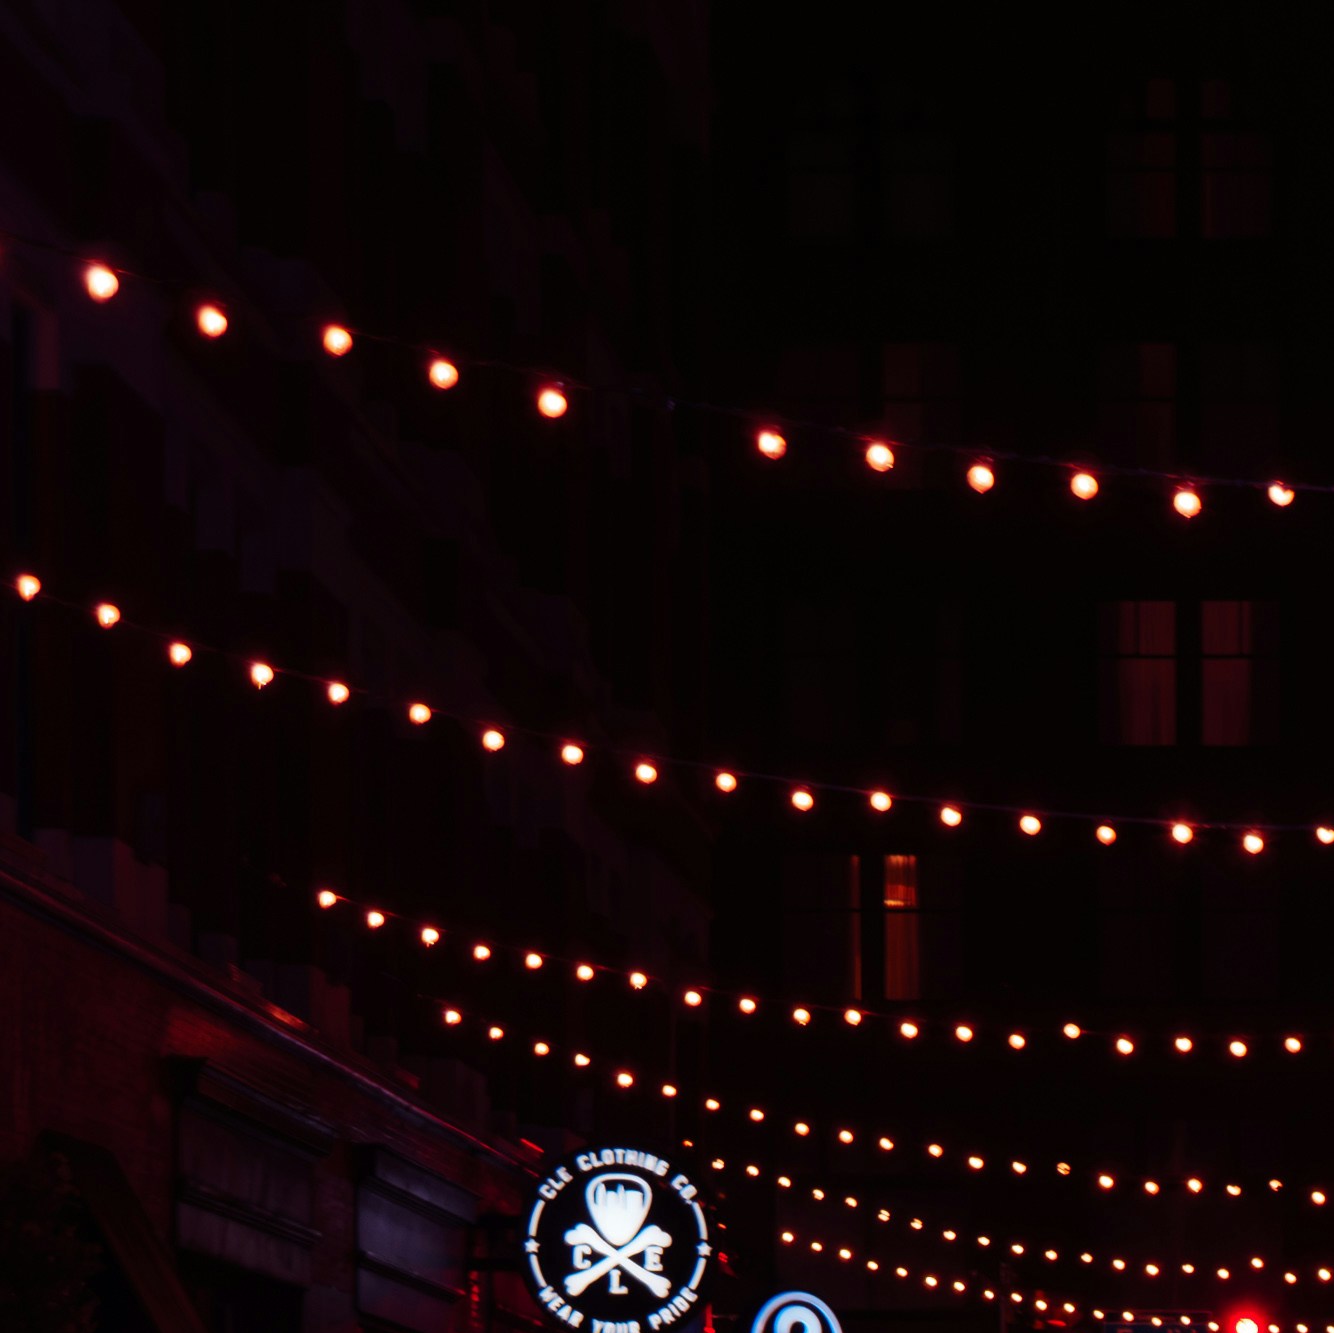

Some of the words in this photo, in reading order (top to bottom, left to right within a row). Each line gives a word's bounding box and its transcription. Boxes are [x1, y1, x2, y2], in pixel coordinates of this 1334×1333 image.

[538, 1166, 573, 1200] CLE
[576, 1148, 670, 1177] CLOTHING
[538, 1285, 584, 1328] WEAR
[648, 1286, 698, 1330] PRIDE
